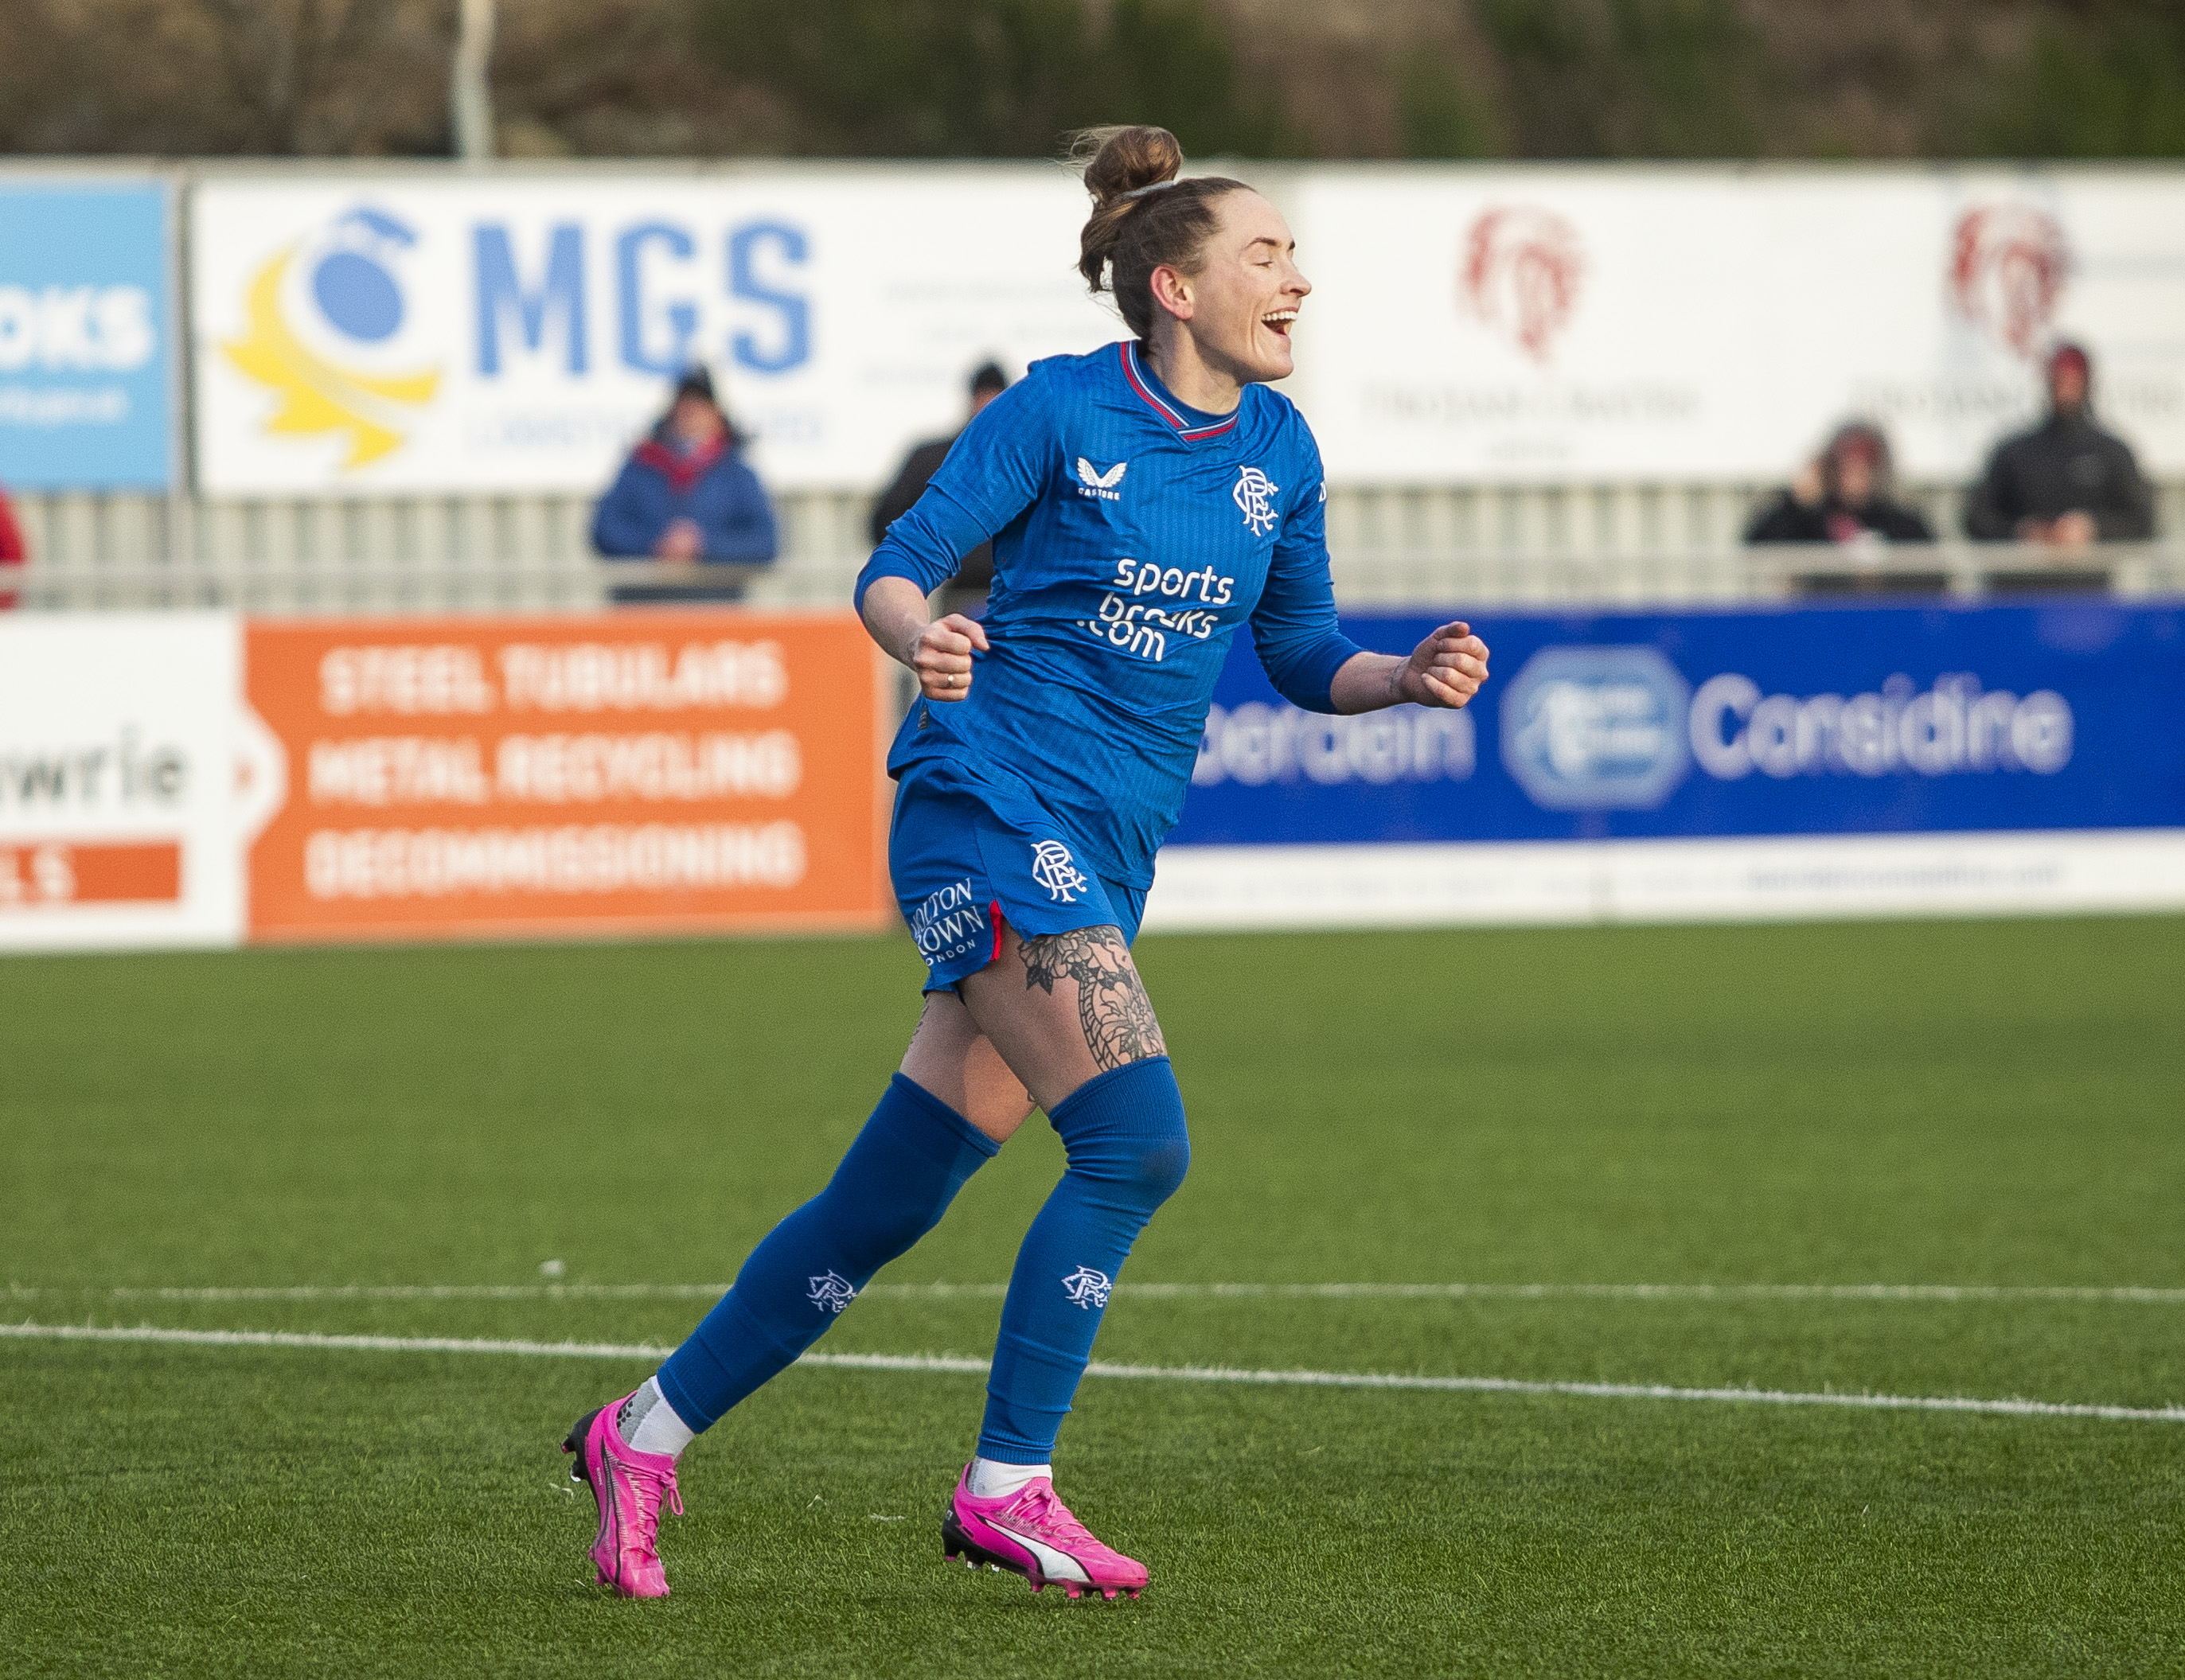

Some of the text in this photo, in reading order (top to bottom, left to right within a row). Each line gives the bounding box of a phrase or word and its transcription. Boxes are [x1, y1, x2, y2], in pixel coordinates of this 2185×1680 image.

[470, 220, 814, 377] MGS
[1078, 487, 1120, 501] CASTORE
[1099, 591, 1219, 639] brks
[1114, 558, 1235, 605] sports
[322, 640, 787, 714] STEEL TUBULARS
[1691, 673, 2073, 779] Considine
[0, 721, 189, 809] wrie
[310, 731, 802, 805] METAL RECYCLING
[306, 821, 806, 898] DECOMMISSIONING
[925, 939, 976, 966] ONDON
